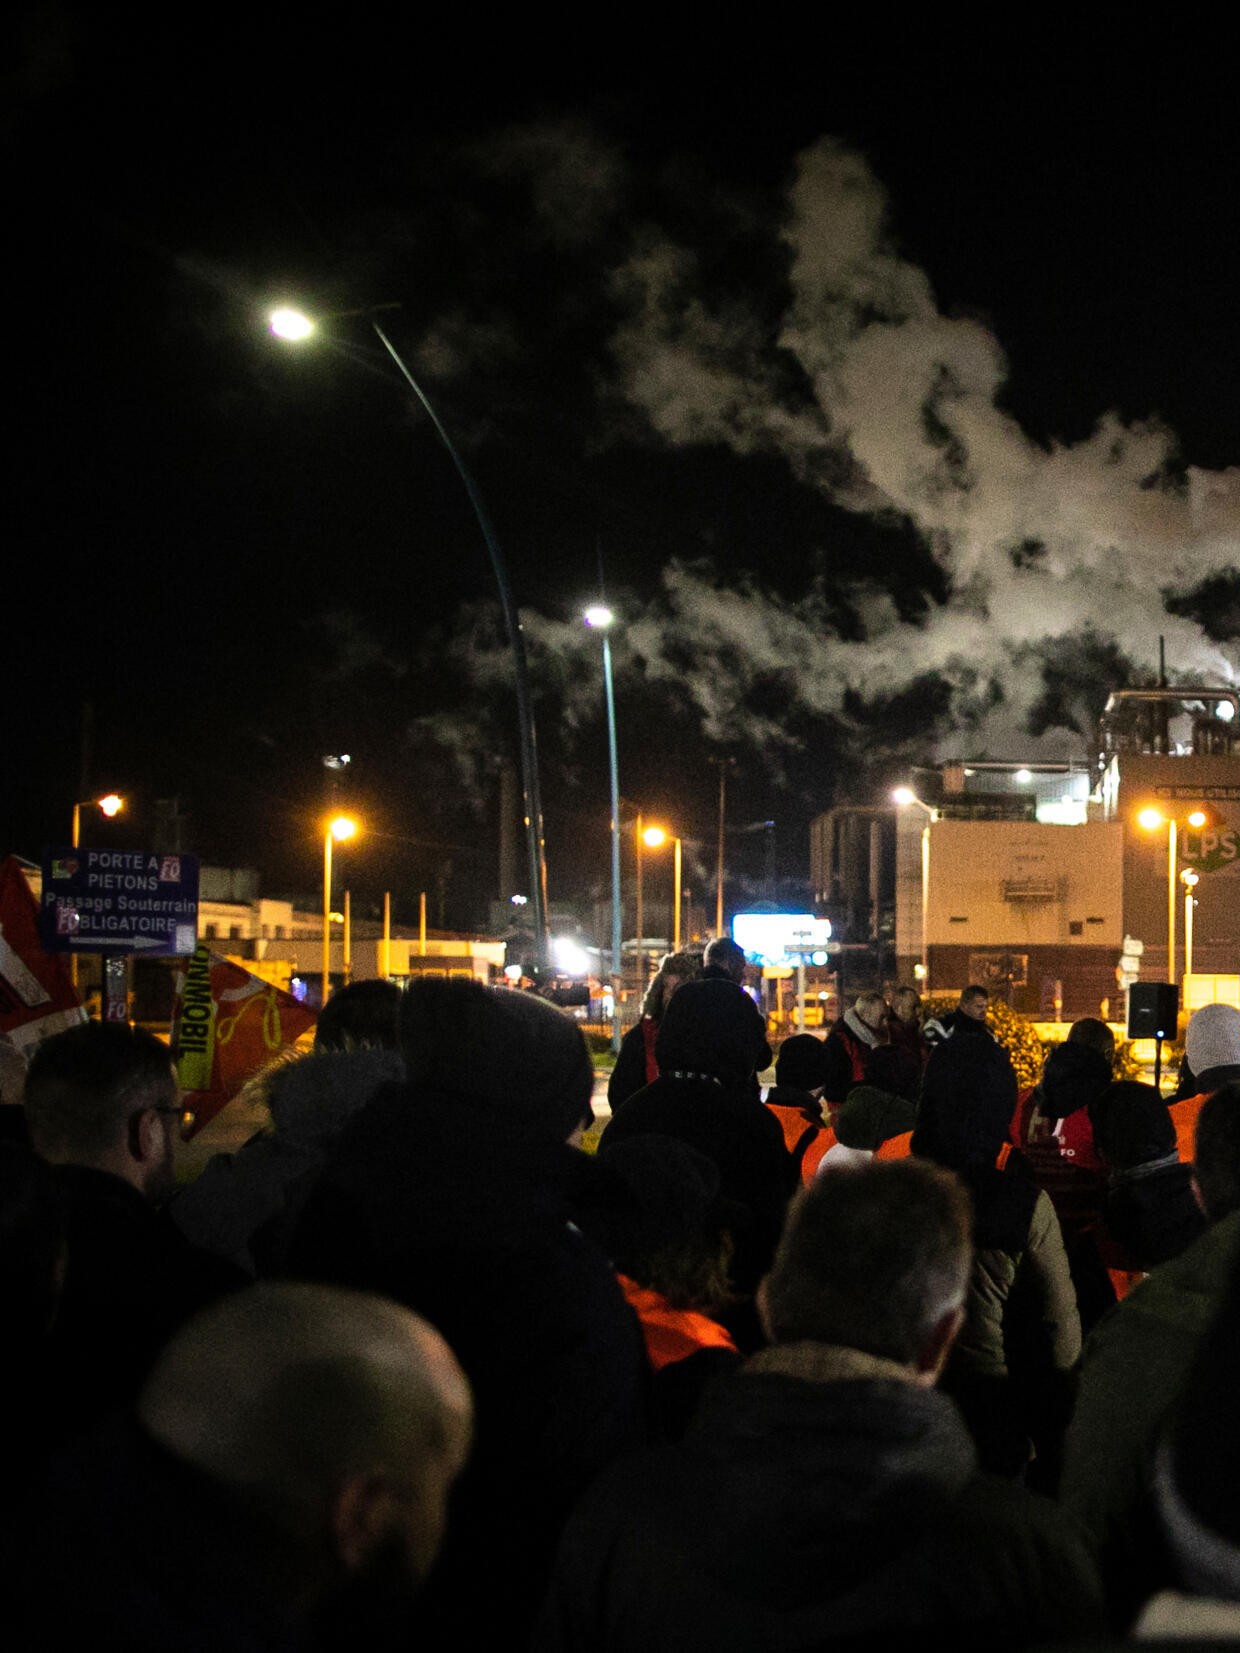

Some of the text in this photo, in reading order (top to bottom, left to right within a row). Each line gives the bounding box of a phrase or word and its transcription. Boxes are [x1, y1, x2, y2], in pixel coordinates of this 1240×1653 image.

[1182, 829, 1239, 859] LPS
[87, 852, 159, 871] PORTE A
[87, 873, 159, 891] PIETONS
[45, 892, 197, 913] Passage Souterrain
[79, 914, 177, 932] BLIGATOIRE
